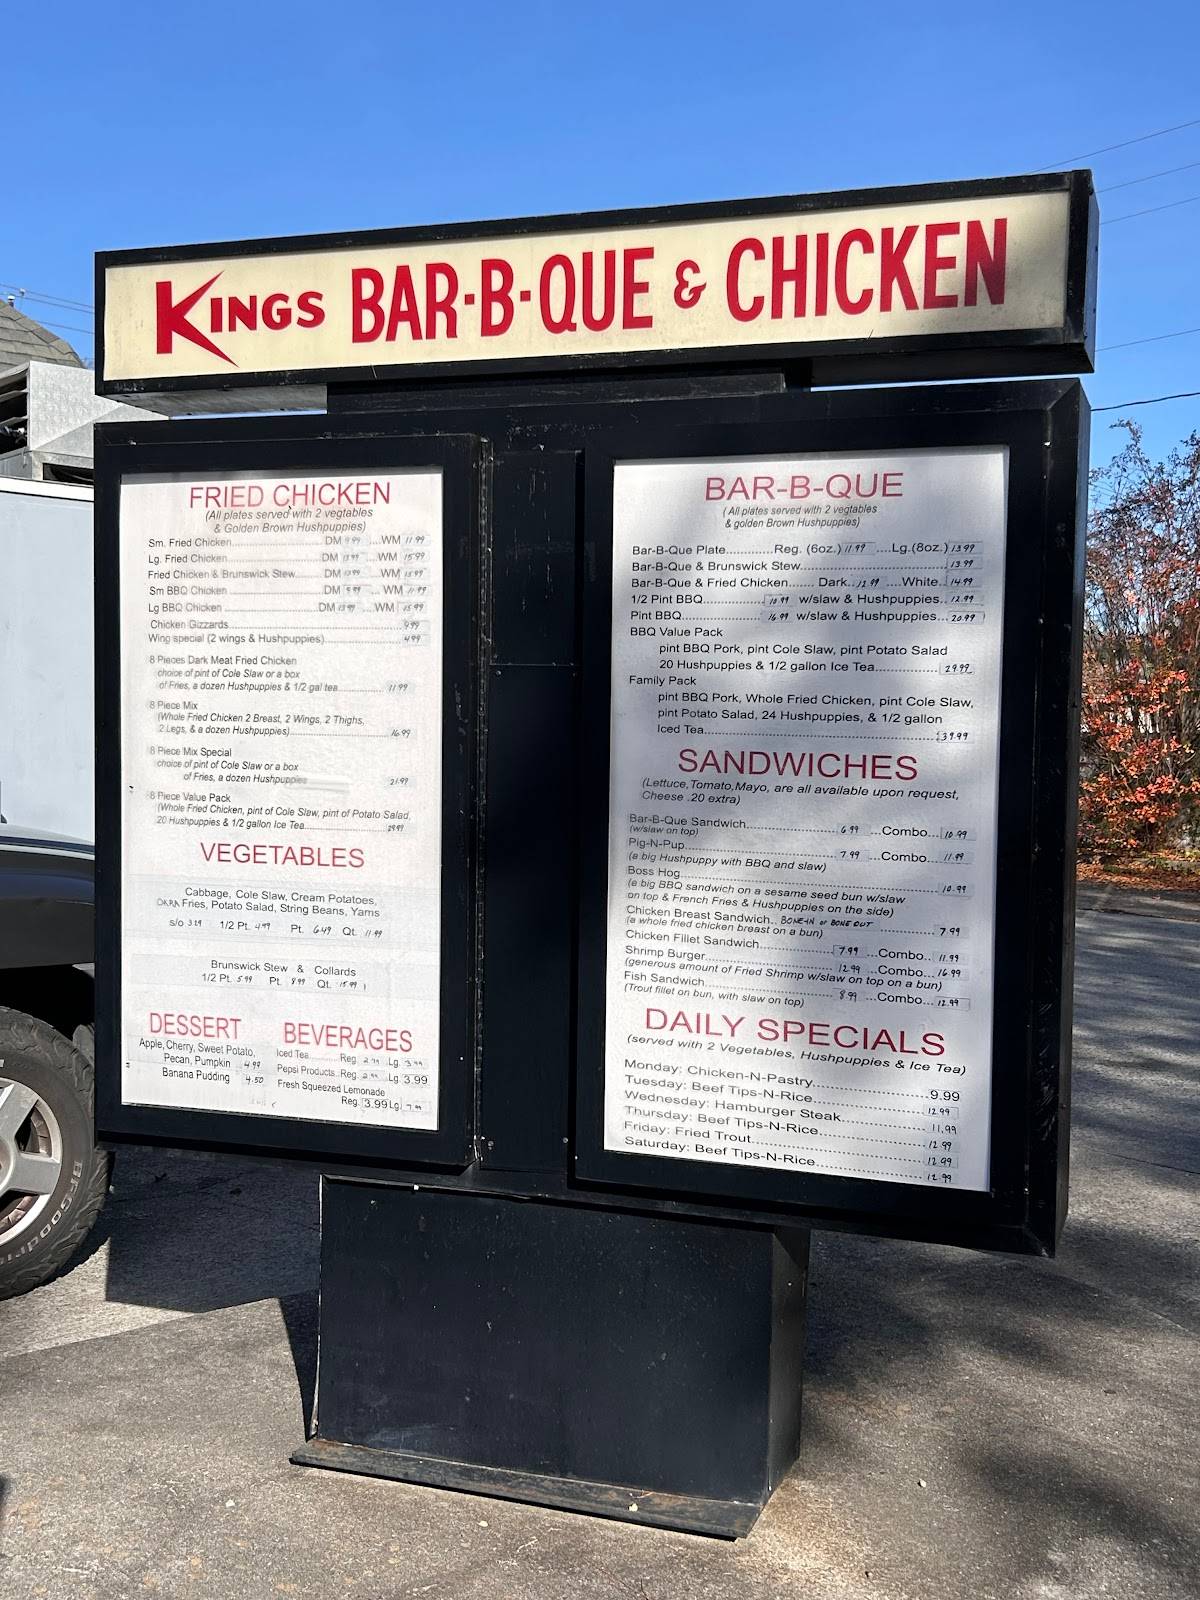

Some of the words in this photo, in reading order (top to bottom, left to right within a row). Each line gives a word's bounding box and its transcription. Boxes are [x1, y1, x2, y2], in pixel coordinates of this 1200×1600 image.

[351, 246, 655, 345] BAR-B-QUE
[674, 259, 707, 309] &
[726, 218, 1008, 322] CHICKEN
[190, 485, 264, 509] FRIED
[273, 482, 391, 506] CHICKEN
[705, 472, 904, 501] BAR-B-QUE
[205, 509, 221, 521] (All
[223, 509, 254, 521] plates
[256, 509, 290, 520] served
[292, 508, 313, 518] with
[315, 508, 321, 518] 2
[324, 507, 373, 519] vegtables
[214, 524, 221, 532] &
[223, 523, 260, 533] Golden
[262, 523, 294, 532] Brown
[296, 521, 367, 532] Hushpuppies)
[148, 538, 166, 548] Sm.
[169, 538, 192, 548] Fried
[194, 537, 232, 548] Chicken
[381, 535, 401, 545] WM
[632, 545, 693, 557] Bar-B-Que
[696, 545, 726, 555] Plate
[774, 544, 801, 556] Reg.
[806, 543, 843, 554] (6oz.)
[632, 561, 693, 572] Bar-B-Que
[696, 561, 704, 571] &
[707, 561, 768, 571] Brunswick
[771, 561, 801, 571] Stew
[631, 578, 692, 589] Bar-B-Que
[696, 578, 704, 587] &
[707, 577, 737, 587] Fried
[740, 577, 789, 587] Chicken
[818, 577, 847, 587] Dark
[902, 576, 938, 587] White
[632, 594, 649, 604] 1/2
[651, 594, 672, 604] Pint
[675, 594, 703, 604] BBQ
[799, 593, 841, 604] w/slaw
[845, 593, 853, 603] &
[857, 593, 940, 606] Hushpuppies
[148, 634, 171, 645] Wing
[173, 633, 204, 645] special
[207, 634, 217, 645] (2
[219, 634, 246, 645] wings
[248, 634, 256, 643] &
[258, 634, 324, 645] Hushpuppies)
[630, 627, 656, 637] BBQ
[659, 627, 691, 637] Value
[695, 627, 723, 637] Pack
[158, 656, 186, 665] Pieces
[188, 656, 208, 665] Dark
[211, 656, 233, 665] Meat
[236, 656, 258, 665] Fried
[260, 656, 297, 666] Chicken
[629, 675, 665, 687] Family
[668, 676, 697, 686] Pack
[658, 691, 680, 704] pint
[683, 692, 708, 703] BBQ
[712, 693, 742, 704] Pork,
[746, 693, 783, 705] Whole
[787, 694, 818, 706] Fried
[822, 695, 875, 707] Chicken,
[879, 695, 902, 709] pint
[906, 697, 935, 708] Cole
[939, 697, 974, 710] Slaw,
[678, 748, 918, 780] SANDWICHES
[158, 791, 181, 802] Piece
[183, 792, 206, 802] Value
[209, 793, 231, 803] Pack
[629, 814, 688, 826] Bar-B-Que
[691, 817, 746, 829] Sandwich
[882, 825, 928, 838] Combo
[200, 842, 365, 868] VEGETABLES
[628, 838, 685, 852] Pig-N-Pup
[881, 851, 927, 864] Combo
[627, 866, 655, 877] Boss
[658, 867, 681, 880] Hog
[185, 887, 232, 900] Cabbage,
[236, 890, 258, 900] Cole
[261, 891, 287, 902] Slaw,
[291, 891, 325, 903] Cream
[328, 893, 377, 906] Potatoes,
[182, 899, 208, 910] Fries,
[211, 899, 243, 911] Potato
[245, 901, 277, 914] Salad,
[280, 903, 309, 916] String
[312, 905, 347, 917] Beans,
[351, 907, 380, 918] Yams
[626, 904, 671, 918] Chicken
[674, 908, 712, 920] Breast
[714, 911, 771, 925] Sandwich
[625, 929, 669, 942] Chicken
[673, 933, 701, 945] Fillet
[704, 935, 760, 949] Sandwich
[878, 948, 924, 961] Combo
[211, 960, 261, 972] Brunswick
[263, 962, 288, 973] Stew
[297, 964, 304, 974] &
[314, 965, 357, 977] Collards
[625, 945, 665, 959] Shrimp
[667, 949, 706, 963] Burger
[878, 964, 924, 977] Combo
[624, 971, 647, 982] Fish
[651, 973, 705, 987] Sandwich
[877, 992, 923, 1005] Combo
[150, 1013, 242, 1039] DESSERT
[284, 1022, 412, 1052] BEVERAGES
[645, 1008, 746, 1037] DAILY
[757, 1018, 945, 1056] SPECIALS
[164, 1053, 191, 1066] Pecan,
[195, 1056, 231, 1070] Pumpkin
[626, 1034, 674, 1048] (served
[677, 1038, 703, 1050] with
[707, 1041, 715, 1051] 2
[719, 1043, 796, 1059] Vegetables,
[800, 1050, 890, 1069] Hushpuppies
[895, 1059, 905, 1069] &
[909, 1060, 931, 1072] Ice
[936, 1063, 966, 1076] Tea)
[162, 1067, 193, 1079] Banana
[197, 1070, 230, 1083] Pudding
[245, 1075, 264, 1084] 4.50
[277, 1064, 299, 1076] Pepsi
[301, 1065, 335, 1077] Products
[403, 1074, 428, 1085] 3.99
[624, 1059, 683, 1075] Monday:
[687, 1065, 814, 1090] Chicken-N-Pastry
[929, 1089, 960, 1101] 9.99
[278, 1079, 299, 1091] Fresh
[301, 1081, 341, 1094] Squeezed
[343, 1085, 385, 1097] Lemonade
[624, 1075, 688, 1092] Tuesday:
[692, 1081, 723, 1094] Beef
[728, 1084, 813, 1103] Tips-N-Rice
[364, 1098, 388, 1109] 3.99
[625, 1090, 710, 1110] Wednesday:
[714, 1099, 795, 1120] Hamburger
[800, 1108, 842, 1122] Steak
[625, 1106, 694, 1123] Thursday:
[697, 1113, 730, 1126] Beef
[734, 1117, 819, 1136] Tips-N-Rice
[624, 1121, 671, 1137] Friday:
[675, 1126, 710, 1139] Fried
[714, 1130, 752, 1143] Trout
[624, 1136, 691, 1154] Saturday:
[695, 1143, 728, 1156] Beef
[733, 1148, 815, 1167] Tips-N-Rice
